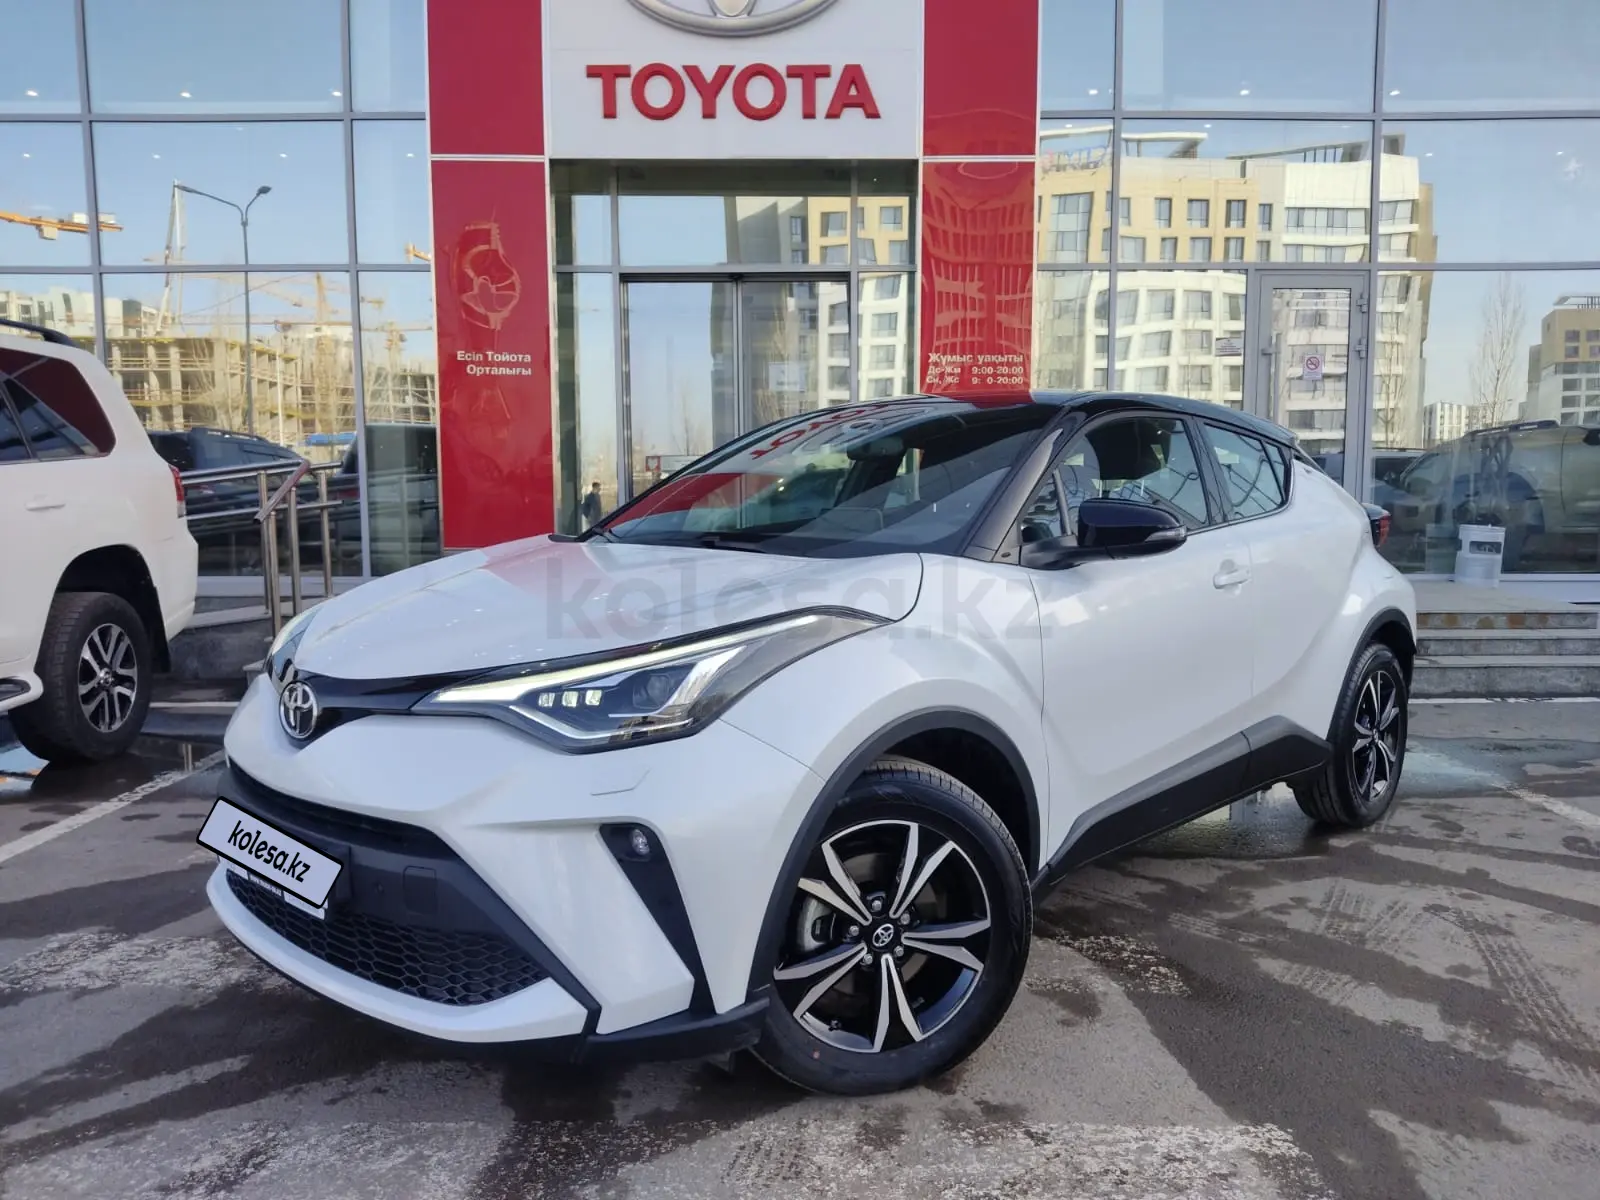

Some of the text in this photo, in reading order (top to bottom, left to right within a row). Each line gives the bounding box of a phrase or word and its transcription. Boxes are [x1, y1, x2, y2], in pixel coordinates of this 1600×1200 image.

[585, 62, 882, 121] TOYOTA
[485, 351, 532, 363] Тойота
[971, 366, 1024, 375] 9:00-20:00
